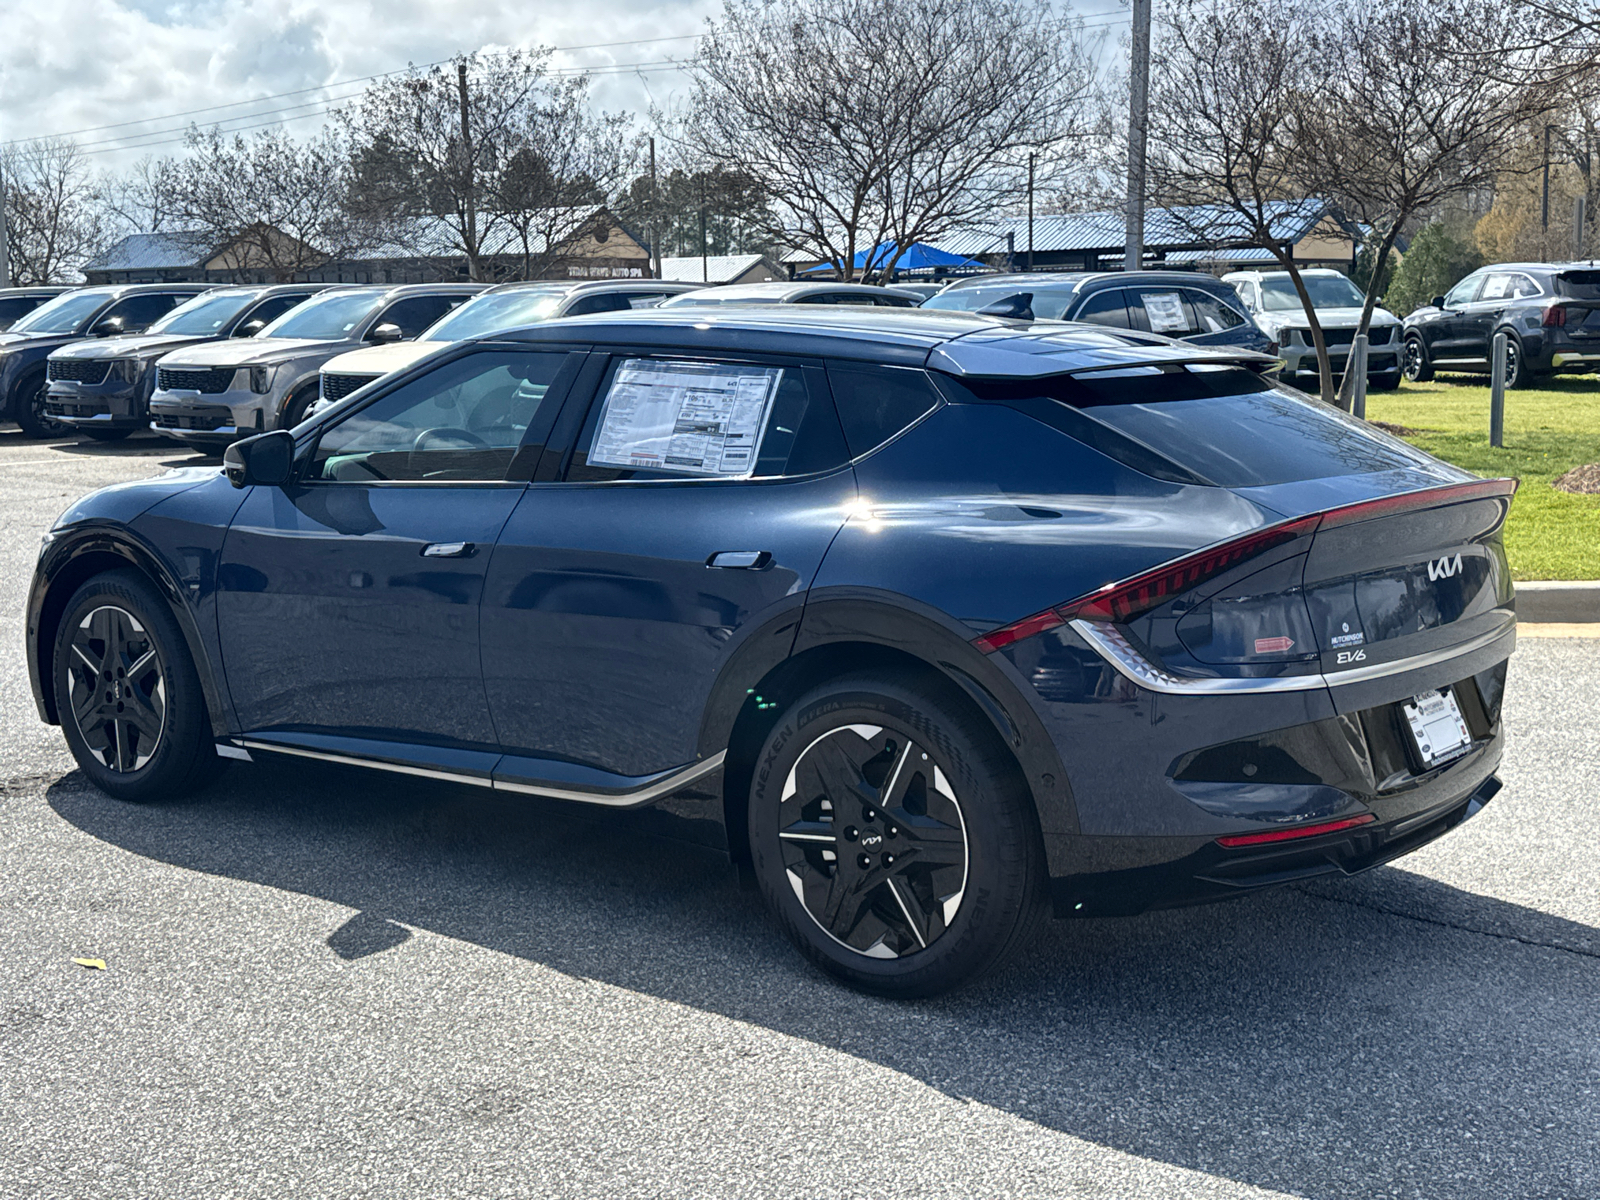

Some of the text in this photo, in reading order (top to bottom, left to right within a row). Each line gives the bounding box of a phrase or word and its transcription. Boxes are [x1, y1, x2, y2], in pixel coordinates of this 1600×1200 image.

[612, 267, 629, 277] AUTO
[630, 268, 643, 277] SPA
[1427, 552, 1463, 582] KIA
[1331, 632, 1364, 645] HUTCHINSON
[1337, 649, 1367, 664] EV6
[165, 665, 177, 734] NEXEN
[755, 723, 794, 800] NEXEN
